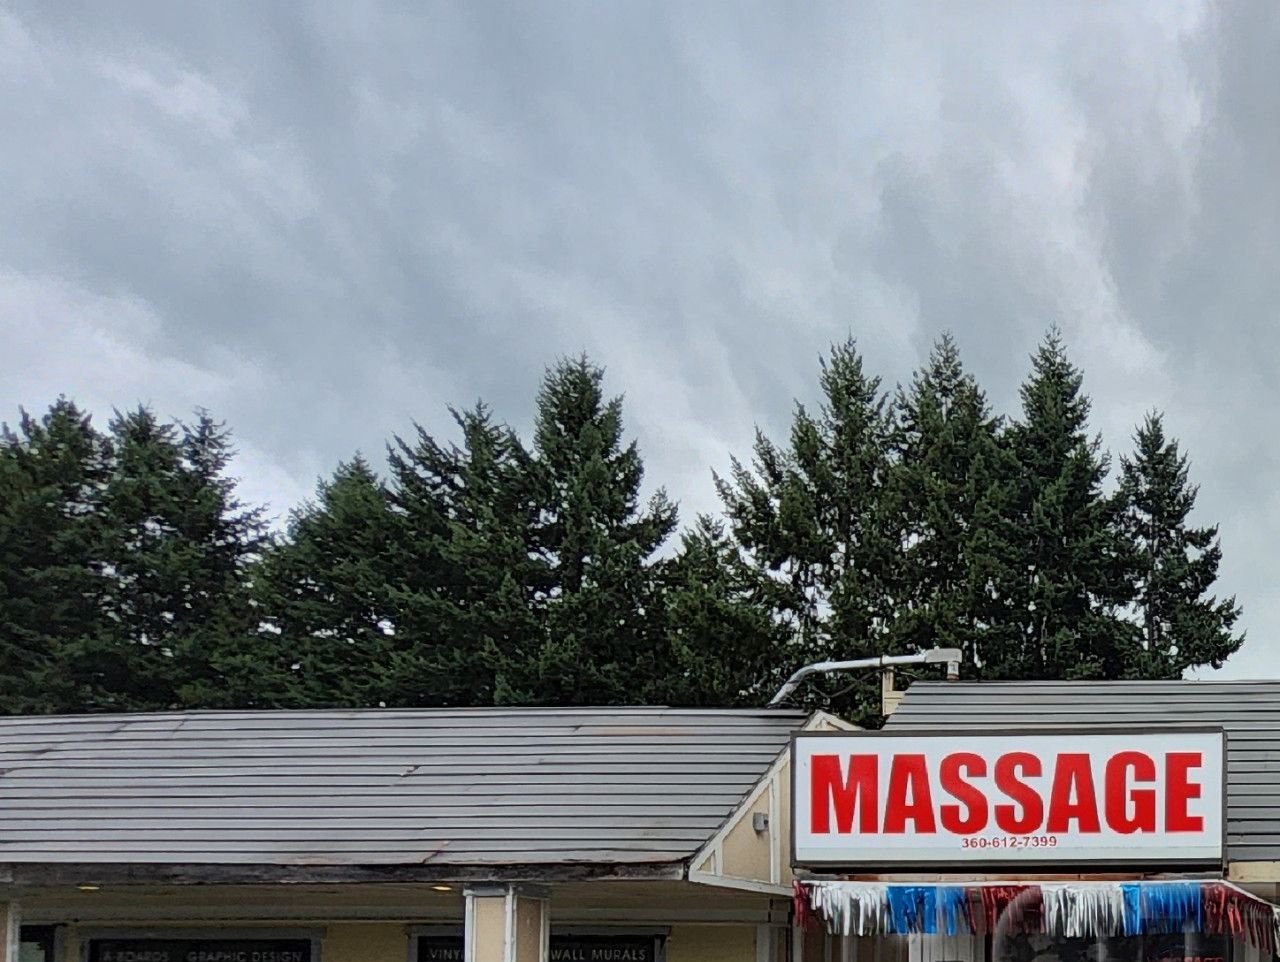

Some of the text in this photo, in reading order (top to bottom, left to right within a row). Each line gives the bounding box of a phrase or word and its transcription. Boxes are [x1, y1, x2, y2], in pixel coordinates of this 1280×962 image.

[810, 751, 1205, 834] MASSAGE
[961, 835, 1058, 849] 360-612-7399
[187, 951, 246, 962] GRAPHIC
[251, 951, 303, 962] DESIGN
[551, 948, 646, 961] WALL MURALS
